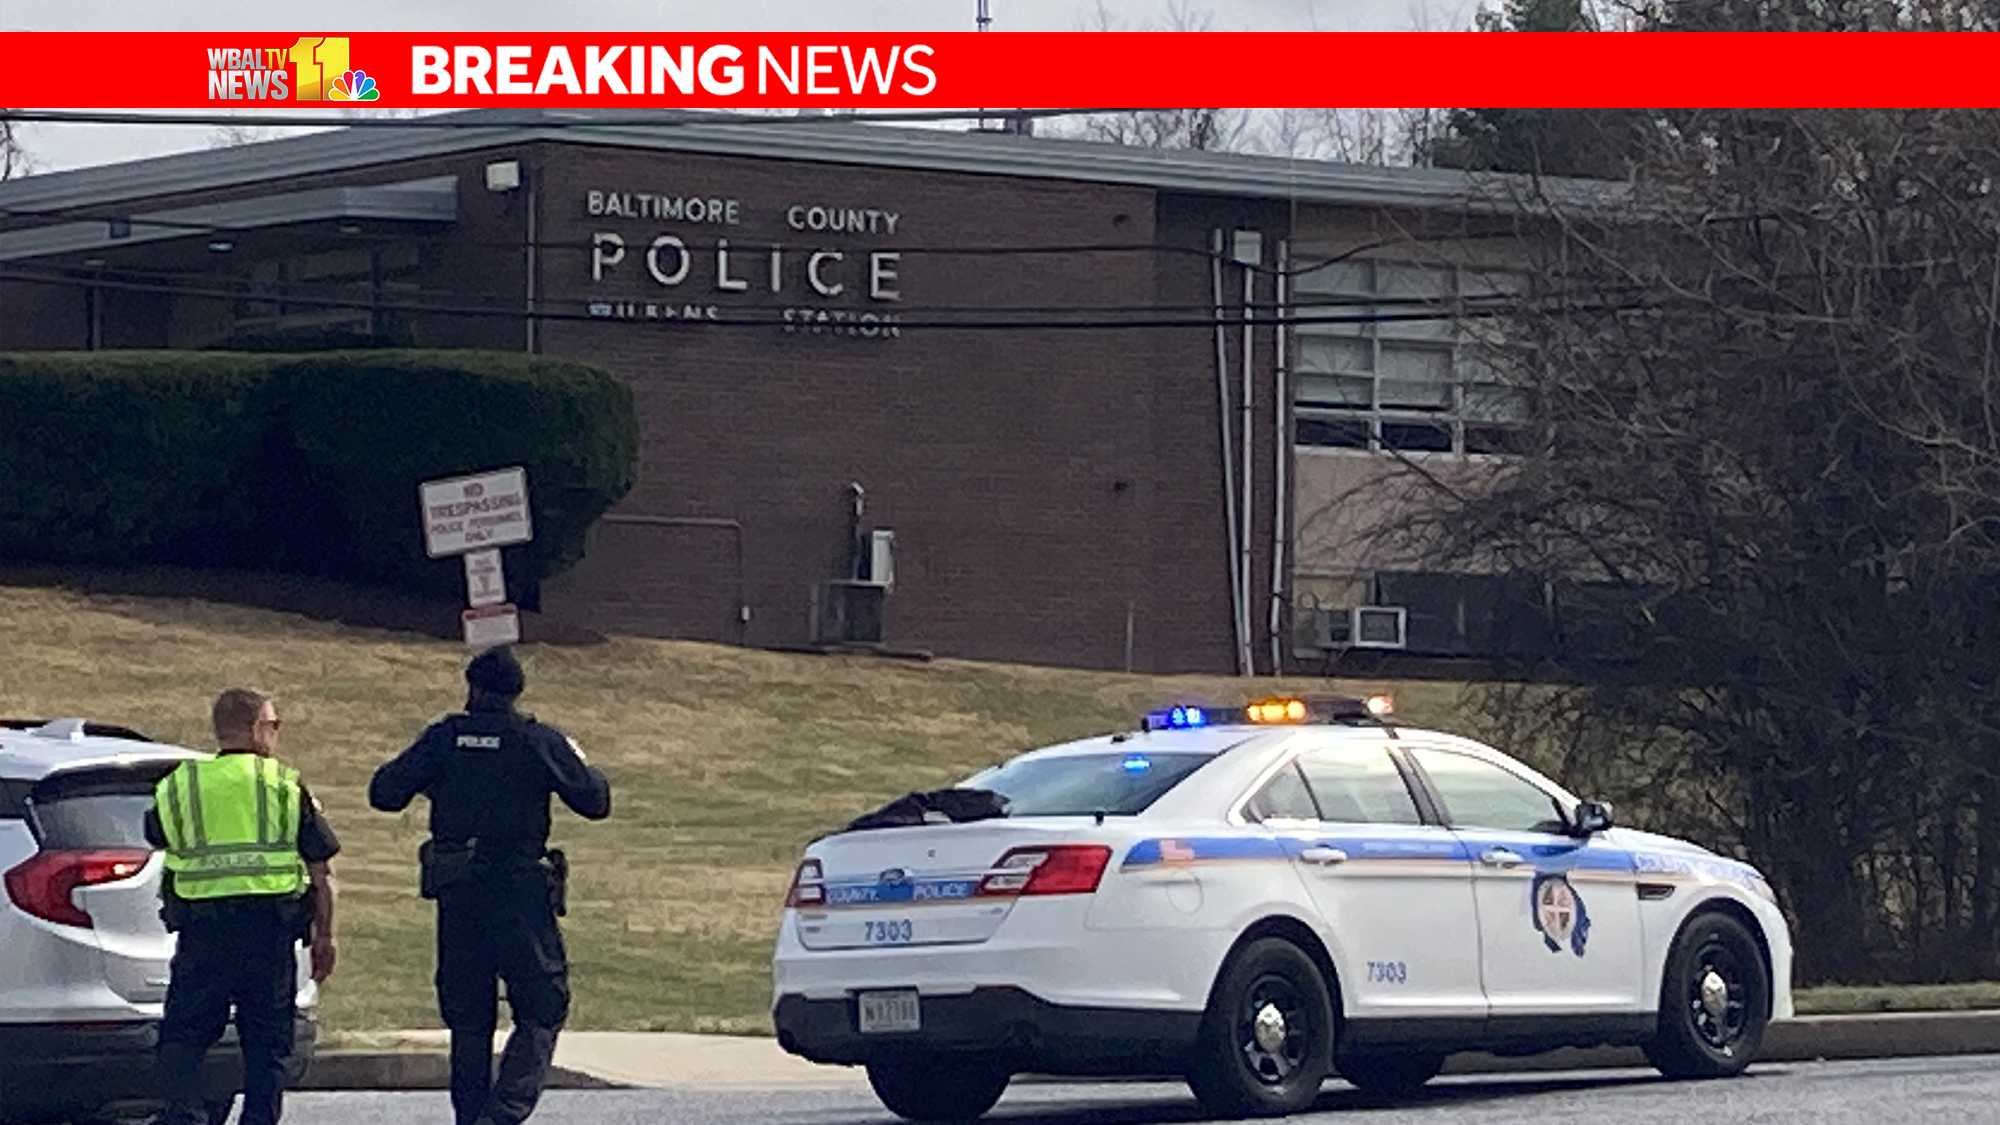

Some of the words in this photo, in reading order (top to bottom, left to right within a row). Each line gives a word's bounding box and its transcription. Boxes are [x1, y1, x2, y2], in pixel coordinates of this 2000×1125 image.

[587, 190, 740, 225] BALTIMORE
[787, 206, 899, 234] COUNTY
[592, 232, 901, 301] POLICE
[864, 919, 912, 942] 7303
[1367, 961, 1407, 984] 7303
